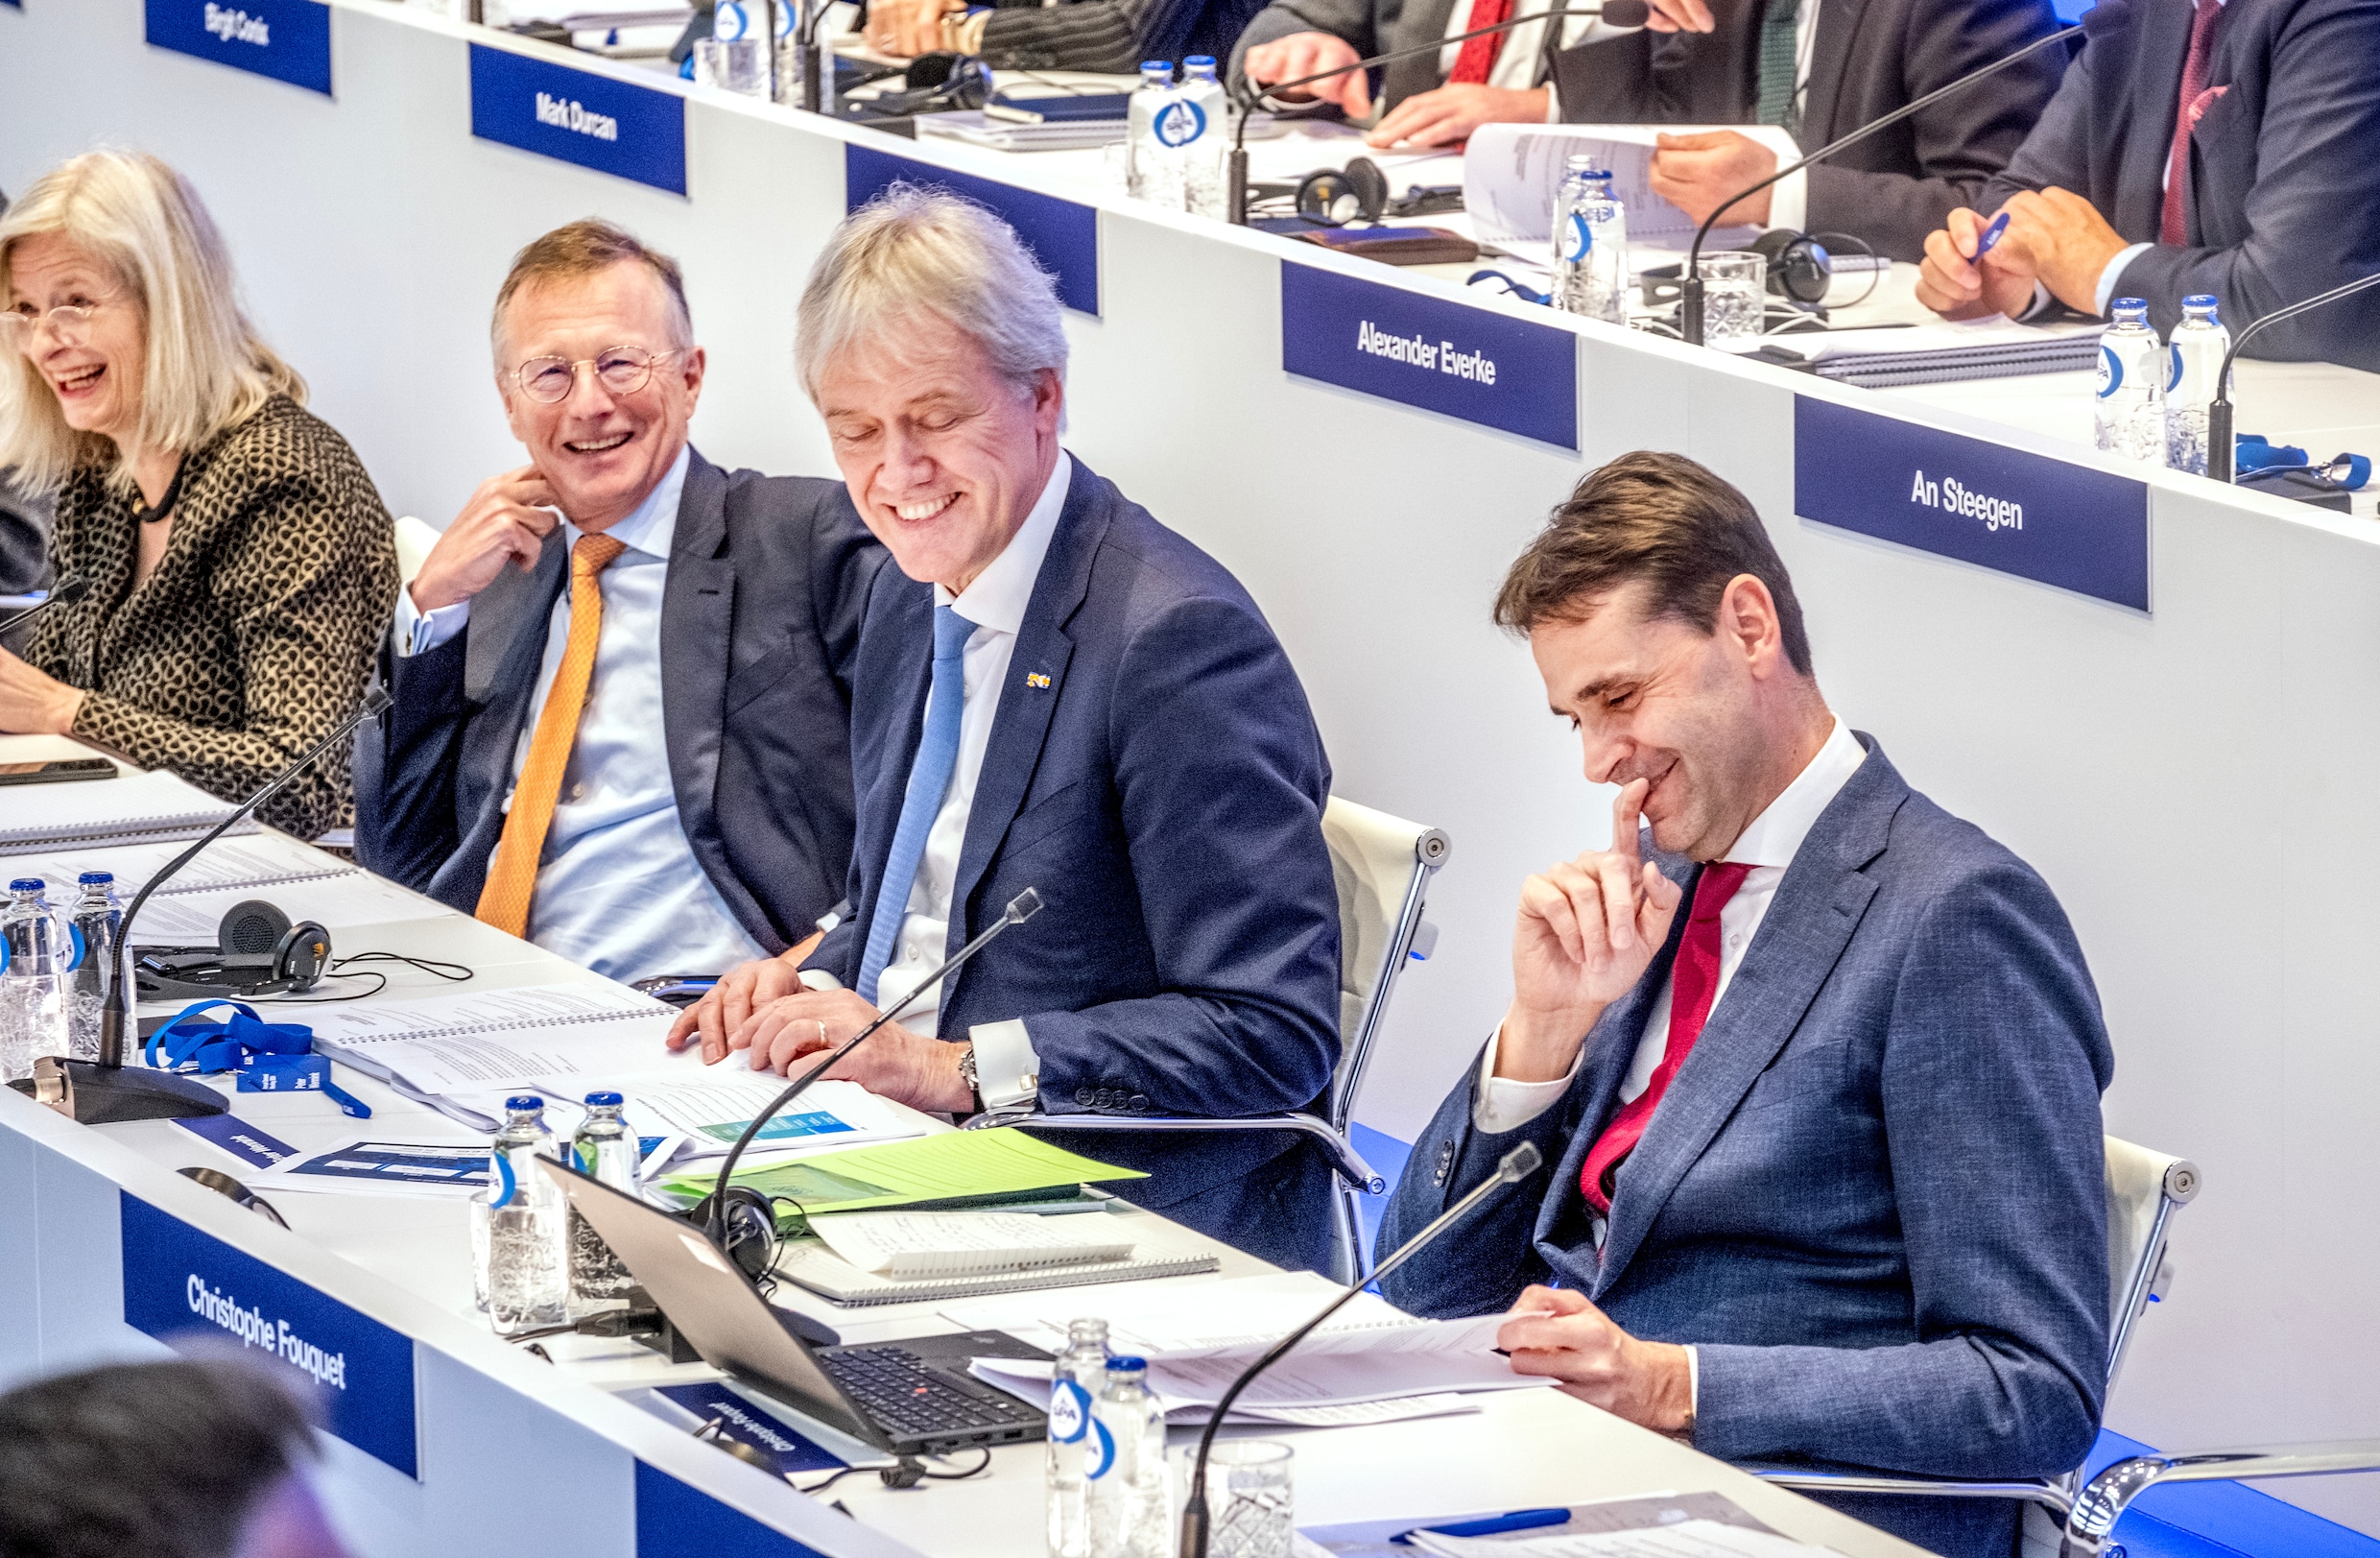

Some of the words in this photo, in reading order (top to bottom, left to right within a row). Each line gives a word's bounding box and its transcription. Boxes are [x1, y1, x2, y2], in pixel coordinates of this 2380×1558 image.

[536, 91, 570, 130] Mark
[570, 101, 617, 141] Durcan
[1357, 320, 1439, 370] Alexander
[1440, 341, 1496, 385] Everke
[1911, 469, 1939, 508] An
[1942, 477, 2023, 532] Steegen
[187, 1274, 275, 1353] Christophe
[277, 1318, 346, 1390] Fouquet
